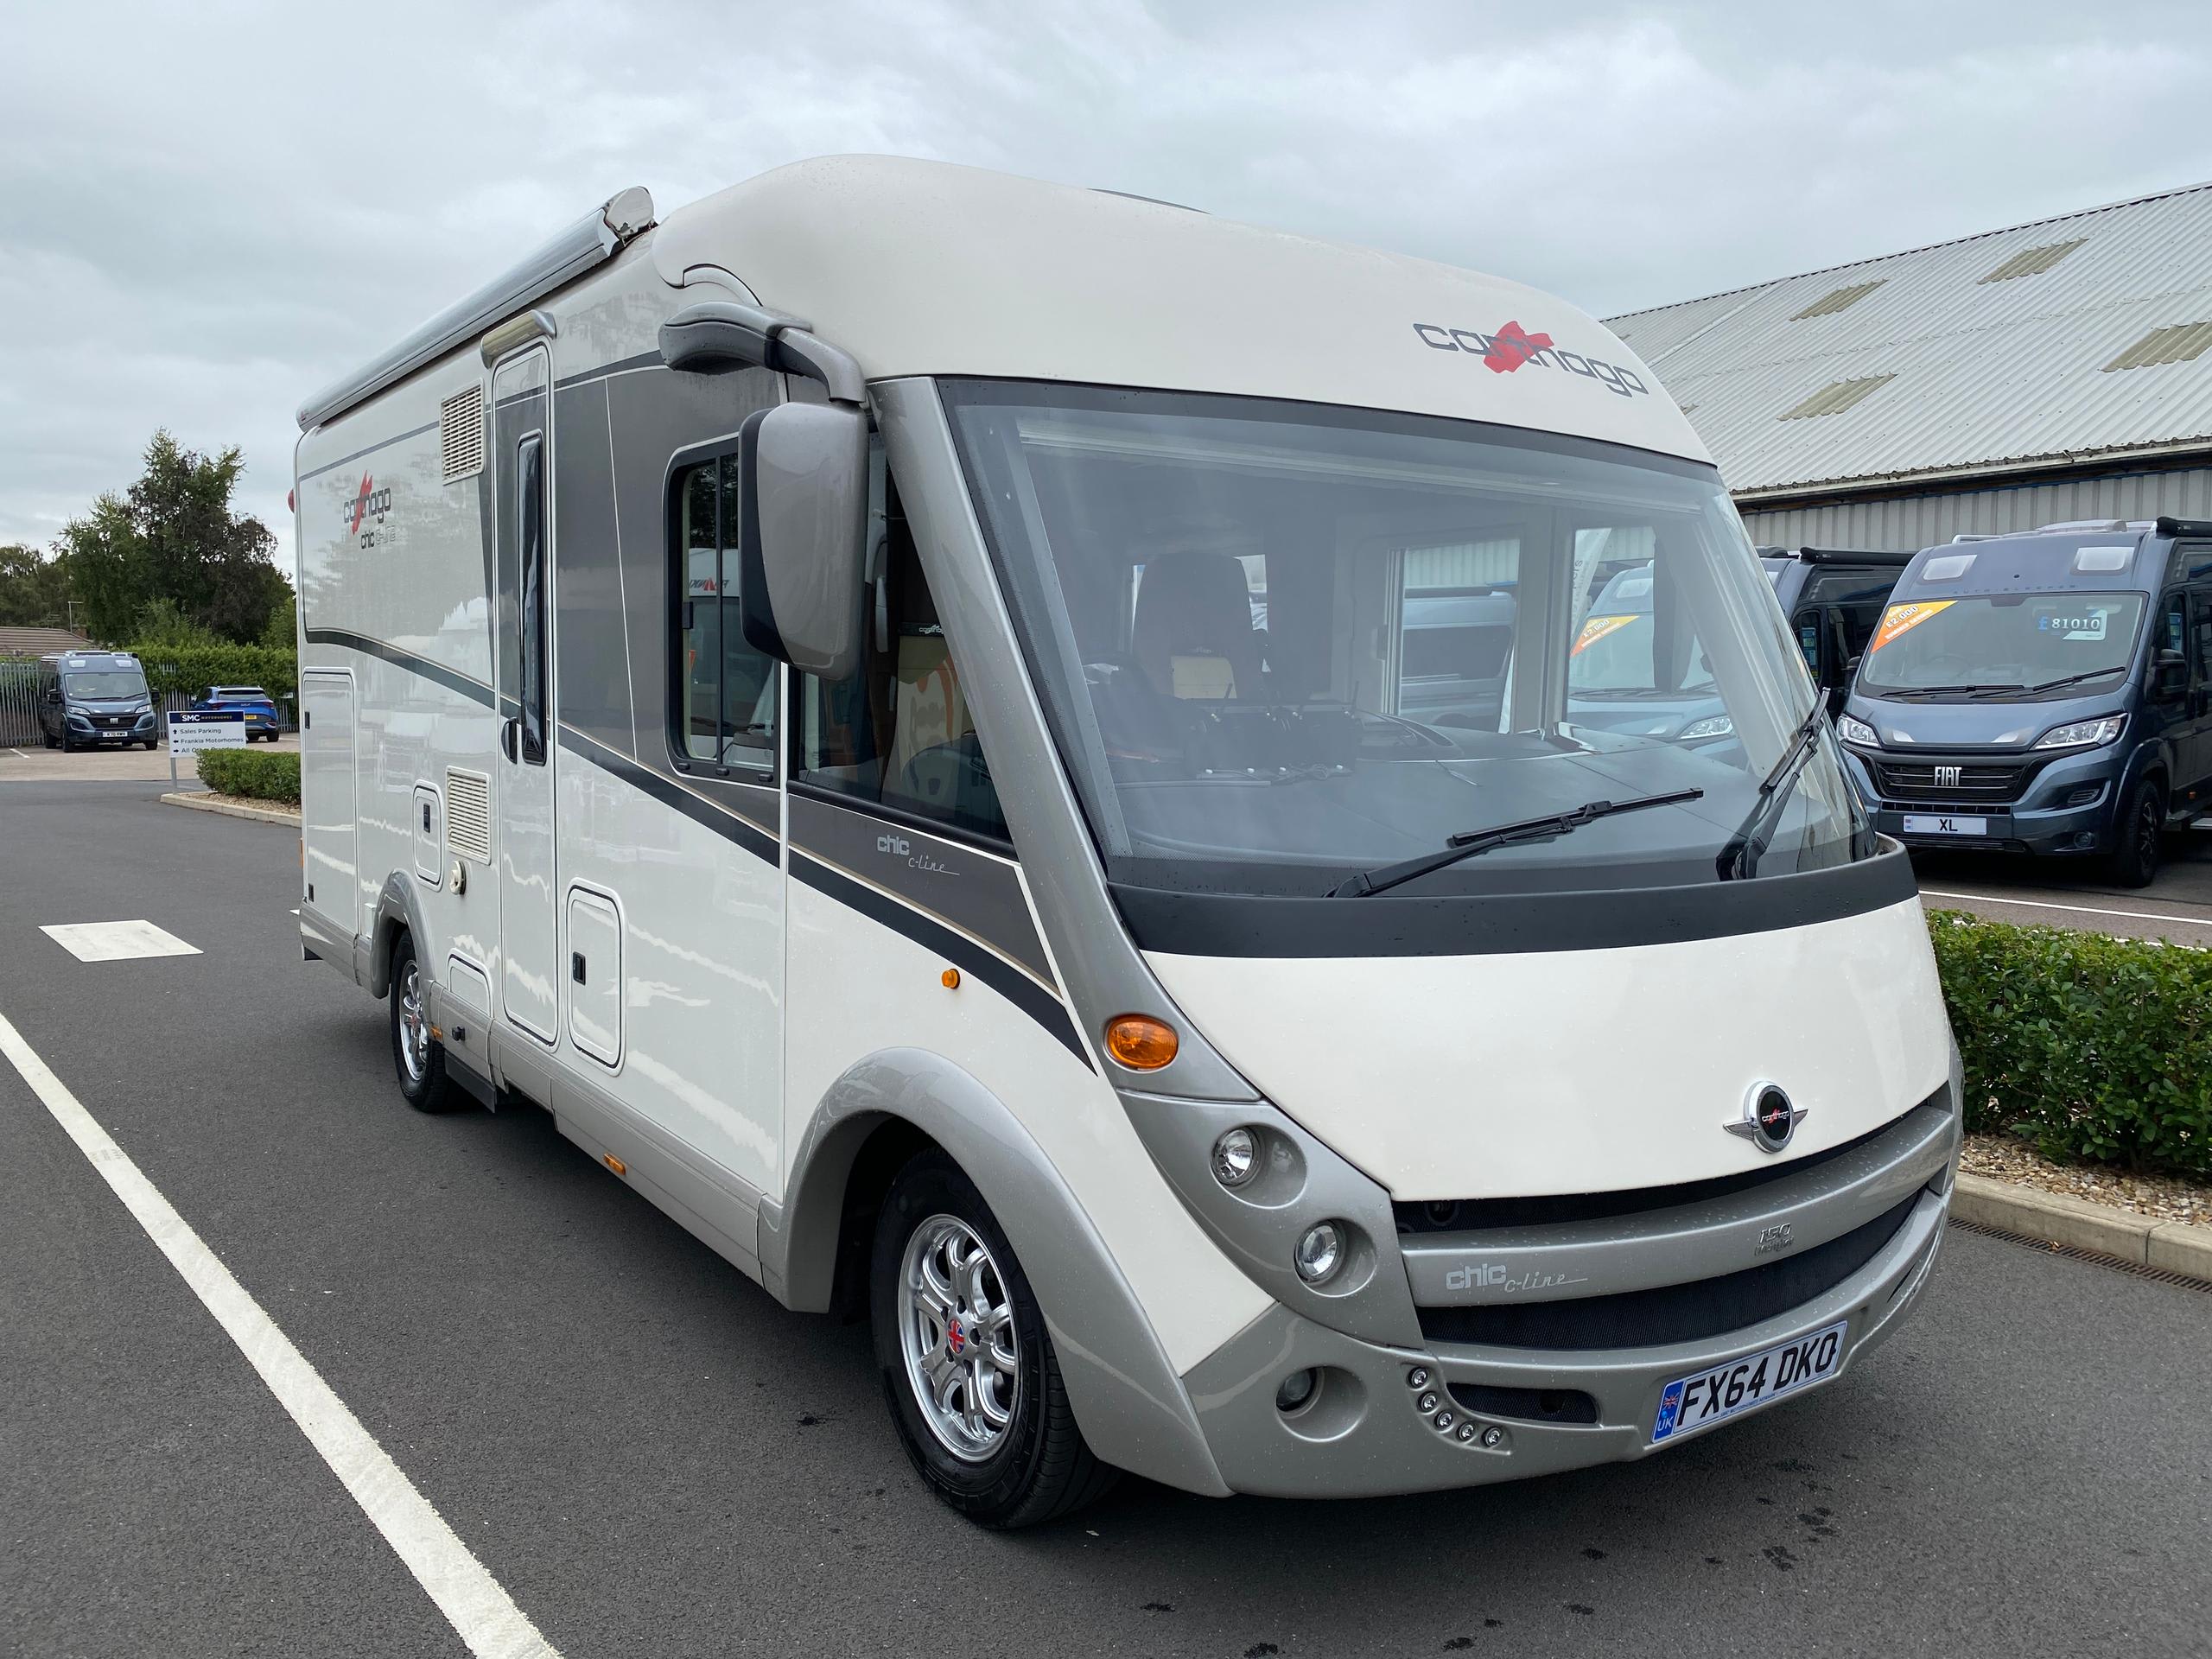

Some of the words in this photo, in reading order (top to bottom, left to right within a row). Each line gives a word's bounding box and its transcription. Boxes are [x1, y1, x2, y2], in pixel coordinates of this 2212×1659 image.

[1934, 766, 1962, 786] FIAT
[1939, 818, 1958, 832] XL
[877, 834, 910, 855] chic
[1446, 1262, 1506, 1290] chic
[1656, 1416, 1673, 1433] UK
[1676, 1356, 1769, 1427] FX64
[1772, 1331, 1838, 1391] DKO
